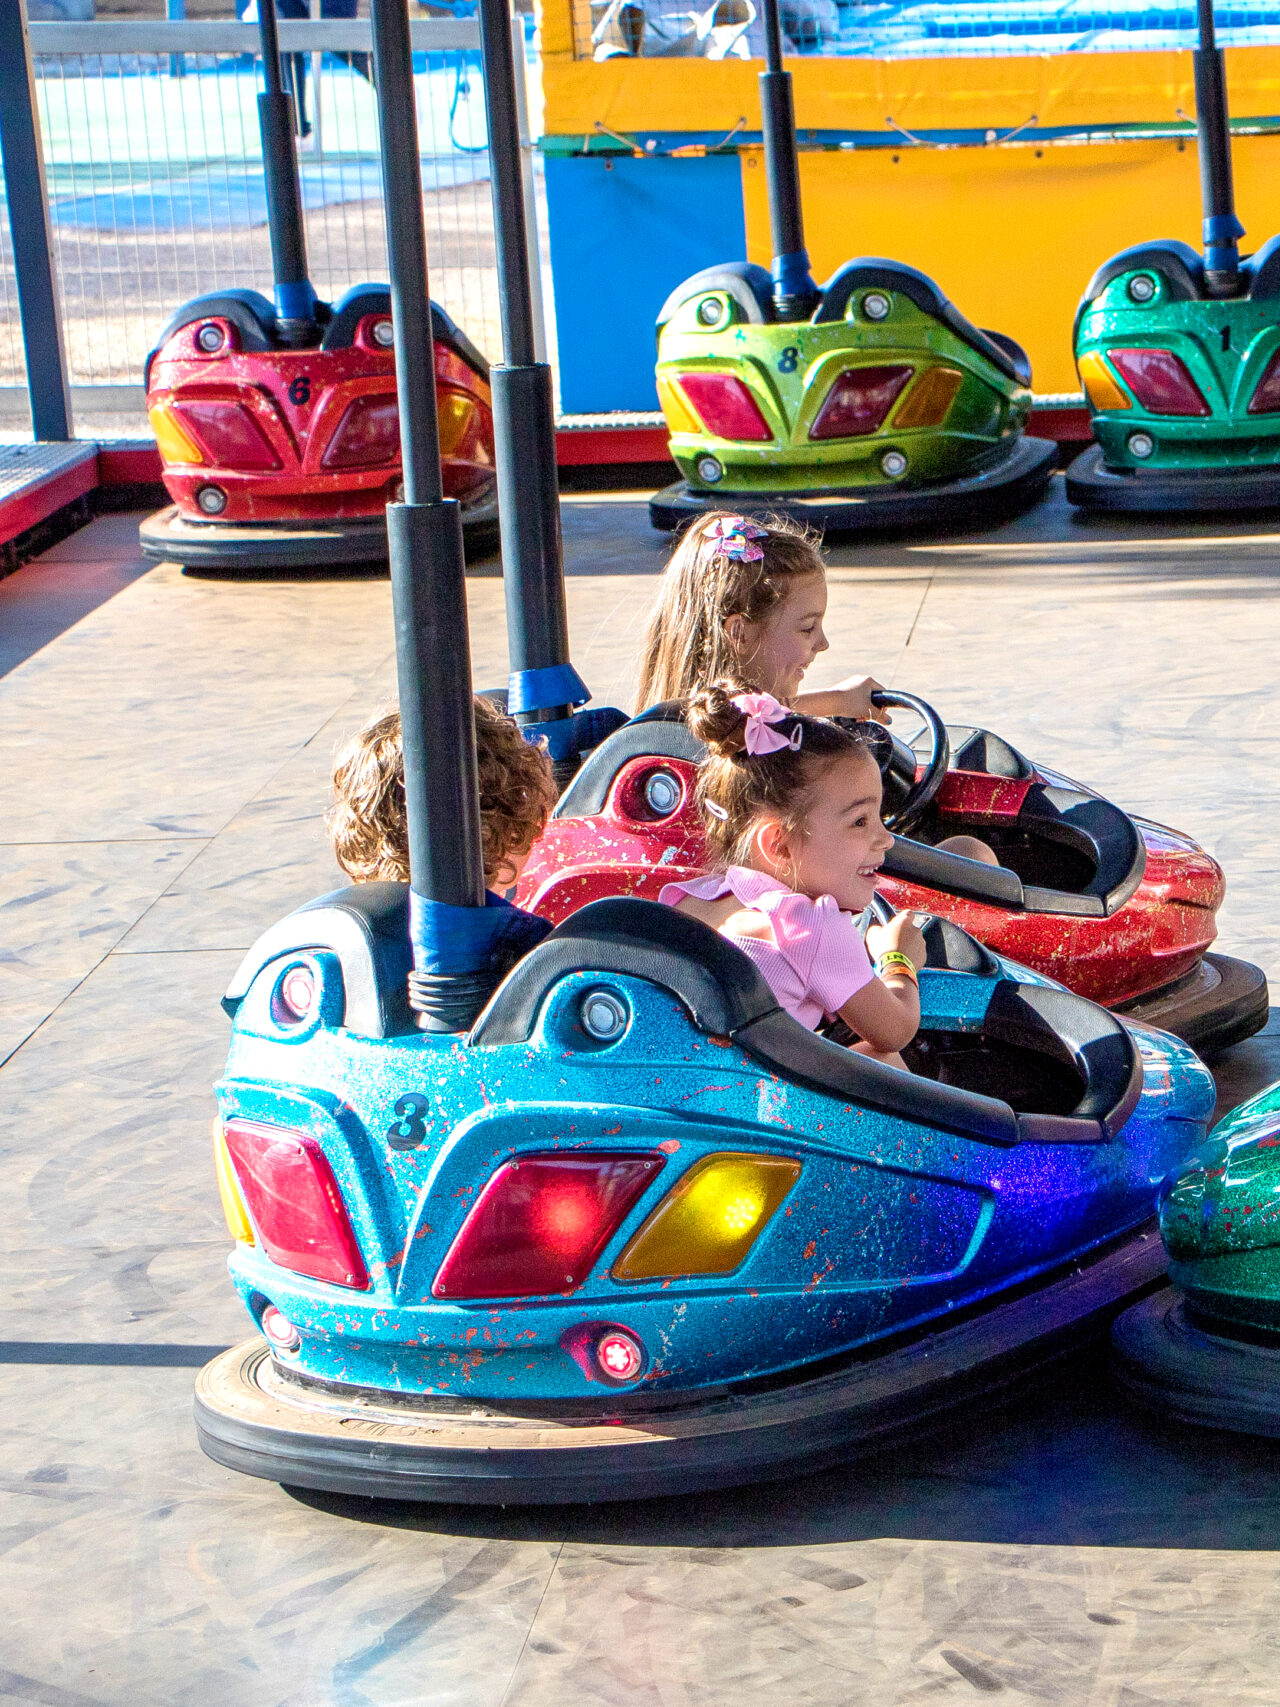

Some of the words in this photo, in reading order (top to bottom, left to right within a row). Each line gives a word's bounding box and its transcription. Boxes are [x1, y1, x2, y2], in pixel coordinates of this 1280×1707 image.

[1220, 325, 1231, 352] 1
[778, 347, 798, 374] 8
[288, 377, 311, 405] 6
[386, 1092, 430, 1151] 3
